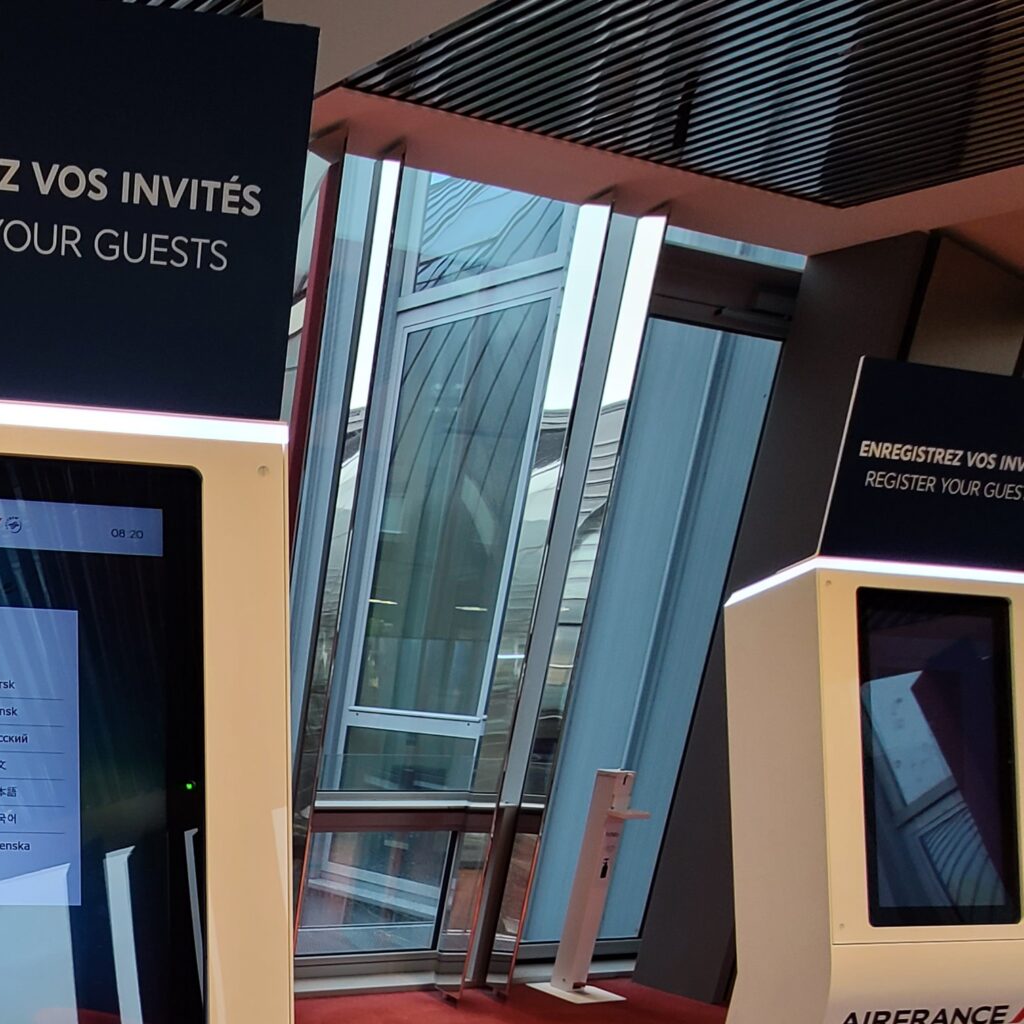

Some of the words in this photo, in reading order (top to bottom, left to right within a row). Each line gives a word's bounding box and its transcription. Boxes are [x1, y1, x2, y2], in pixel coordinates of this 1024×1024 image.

[32, 161, 109, 202] VOS
[121, 172, 263, 218] INVITÉS
[92, 228, 229, 273] GUESTS
[859, 440, 964, 467] ENREGISTREZ
[966, 451, 998, 470] VOS
[865, 470, 937, 493] REGISTER
[940, 477, 981, 497] YOUR
[983, 481, 1024, 501] GUES
